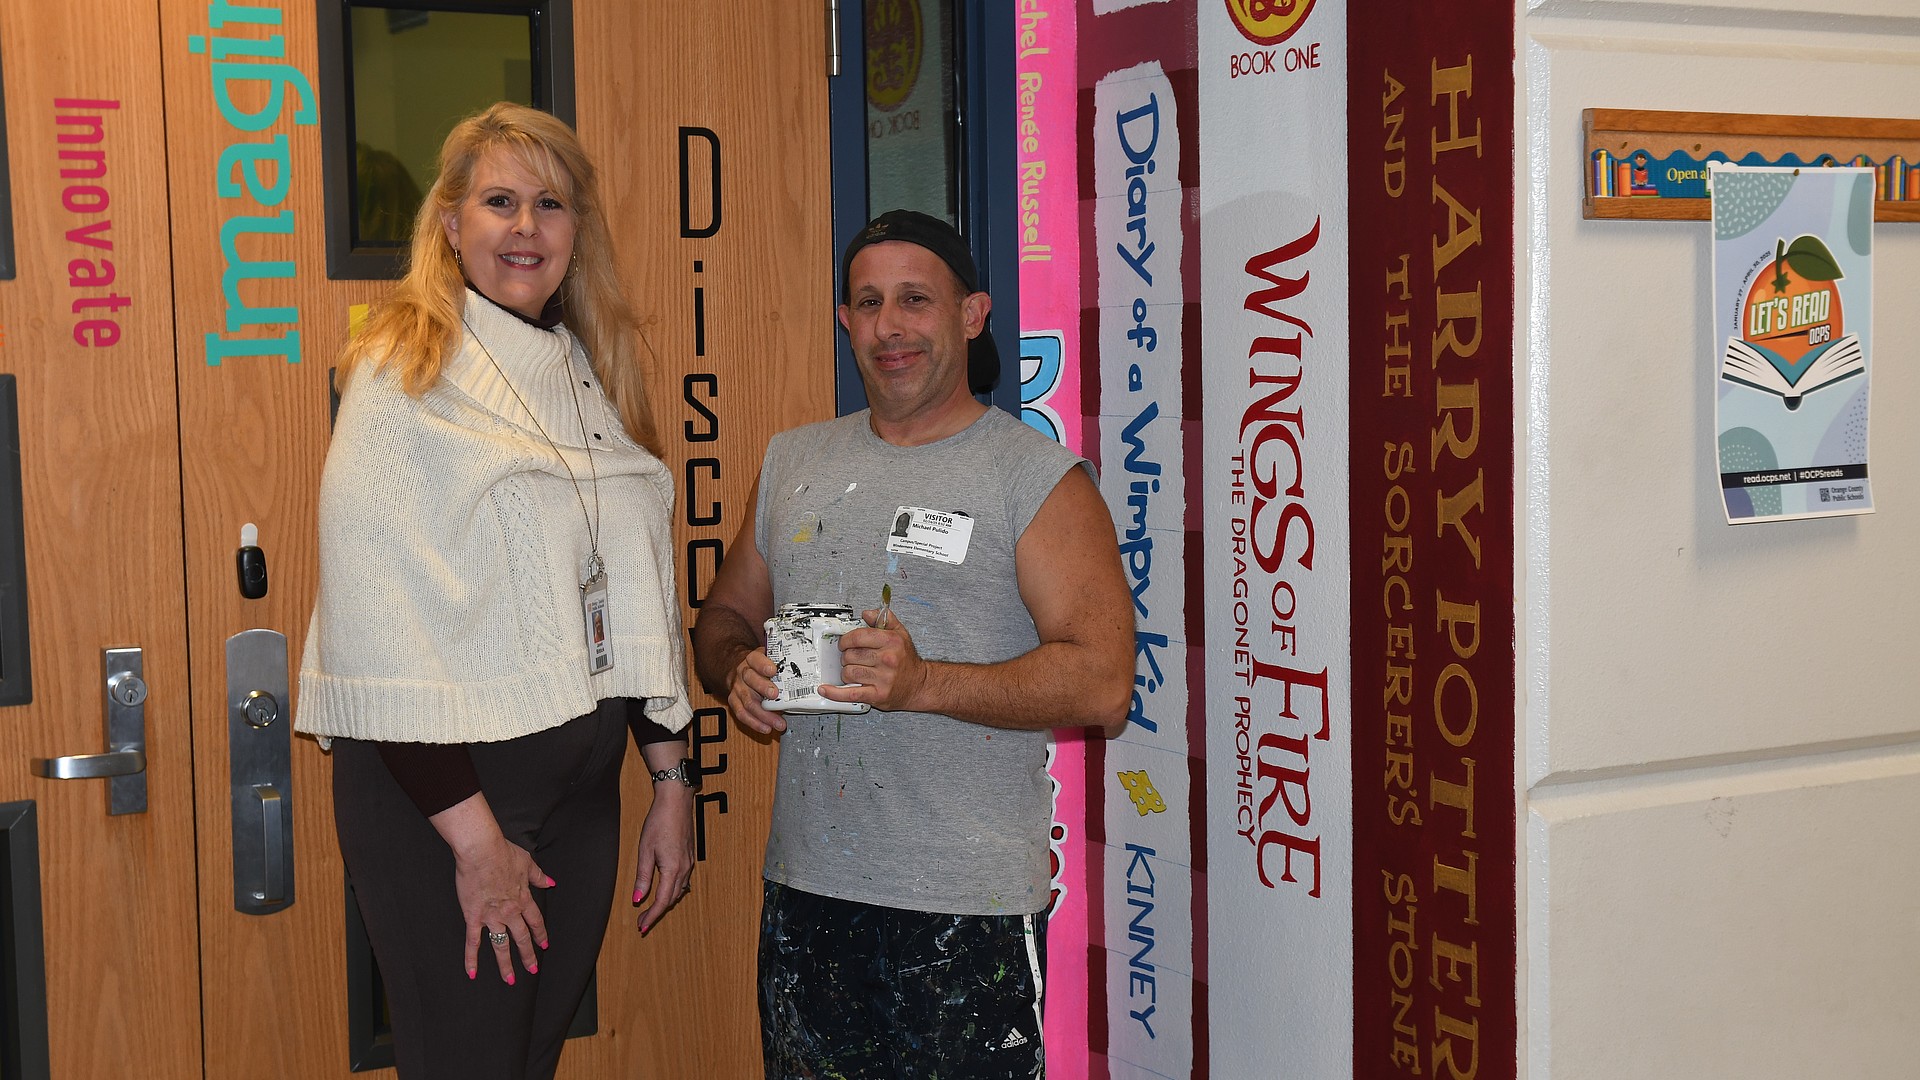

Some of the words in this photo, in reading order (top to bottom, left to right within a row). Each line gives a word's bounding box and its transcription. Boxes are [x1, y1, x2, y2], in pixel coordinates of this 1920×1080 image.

[1019, 72, 1043, 153] Renée
[1231, 50, 1276, 79] BOOK
[1284, 42, 1321, 72] ONE
[1383, 68, 1406, 198] AND
[1666, 167, 1698, 184] Open
[53, 97, 132, 348] Innovate
[1021, 161, 1052, 263] Russell
[1116, 92, 1160, 287] Diary
[1127, 298, 1157, 353] of
[1381, 253, 1414, 398] THE
[1430, 53, 1484, 570] HARRY
[1750, 297, 1789, 337] LET'S
[1791, 289, 1831, 328] READ
[1809, 324, 1831, 346] OCPS
[1127, 363, 1143, 392] a
[1239, 214, 1321, 575] WINGS
[678, 125, 729, 863] Discoer
[912, 523, 932, 531] Michael
[924, 513, 953, 524] VISITOR
[1110, 400, 1161, 619] Wimpy
[1231, 449, 1246, 505] THE
[1743, 473, 1791, 484] read.ocps.net
[1800, 469, 1843, 480] #OCPSreads
[1831, 486, 1847, 495] Orange
[1231, 517, 1251, 687] DRAGONET
[1270, 579, 1297, 657] OF
[1382, 441, 1422, 826] SORCERER'S
[1126, 630, 1168, 734] Kid
[1234, 696, 1256, 847] PROPHECY
[1250, 653, 1331, 900] FIRE
[1431, 588, 1483, 1080] POTTER
[1124, 842, 1156, 1040] KINNEY
[1381, 868, 1423, 1076] STONE
[1000, 1036, 1028, 1049] adidas
